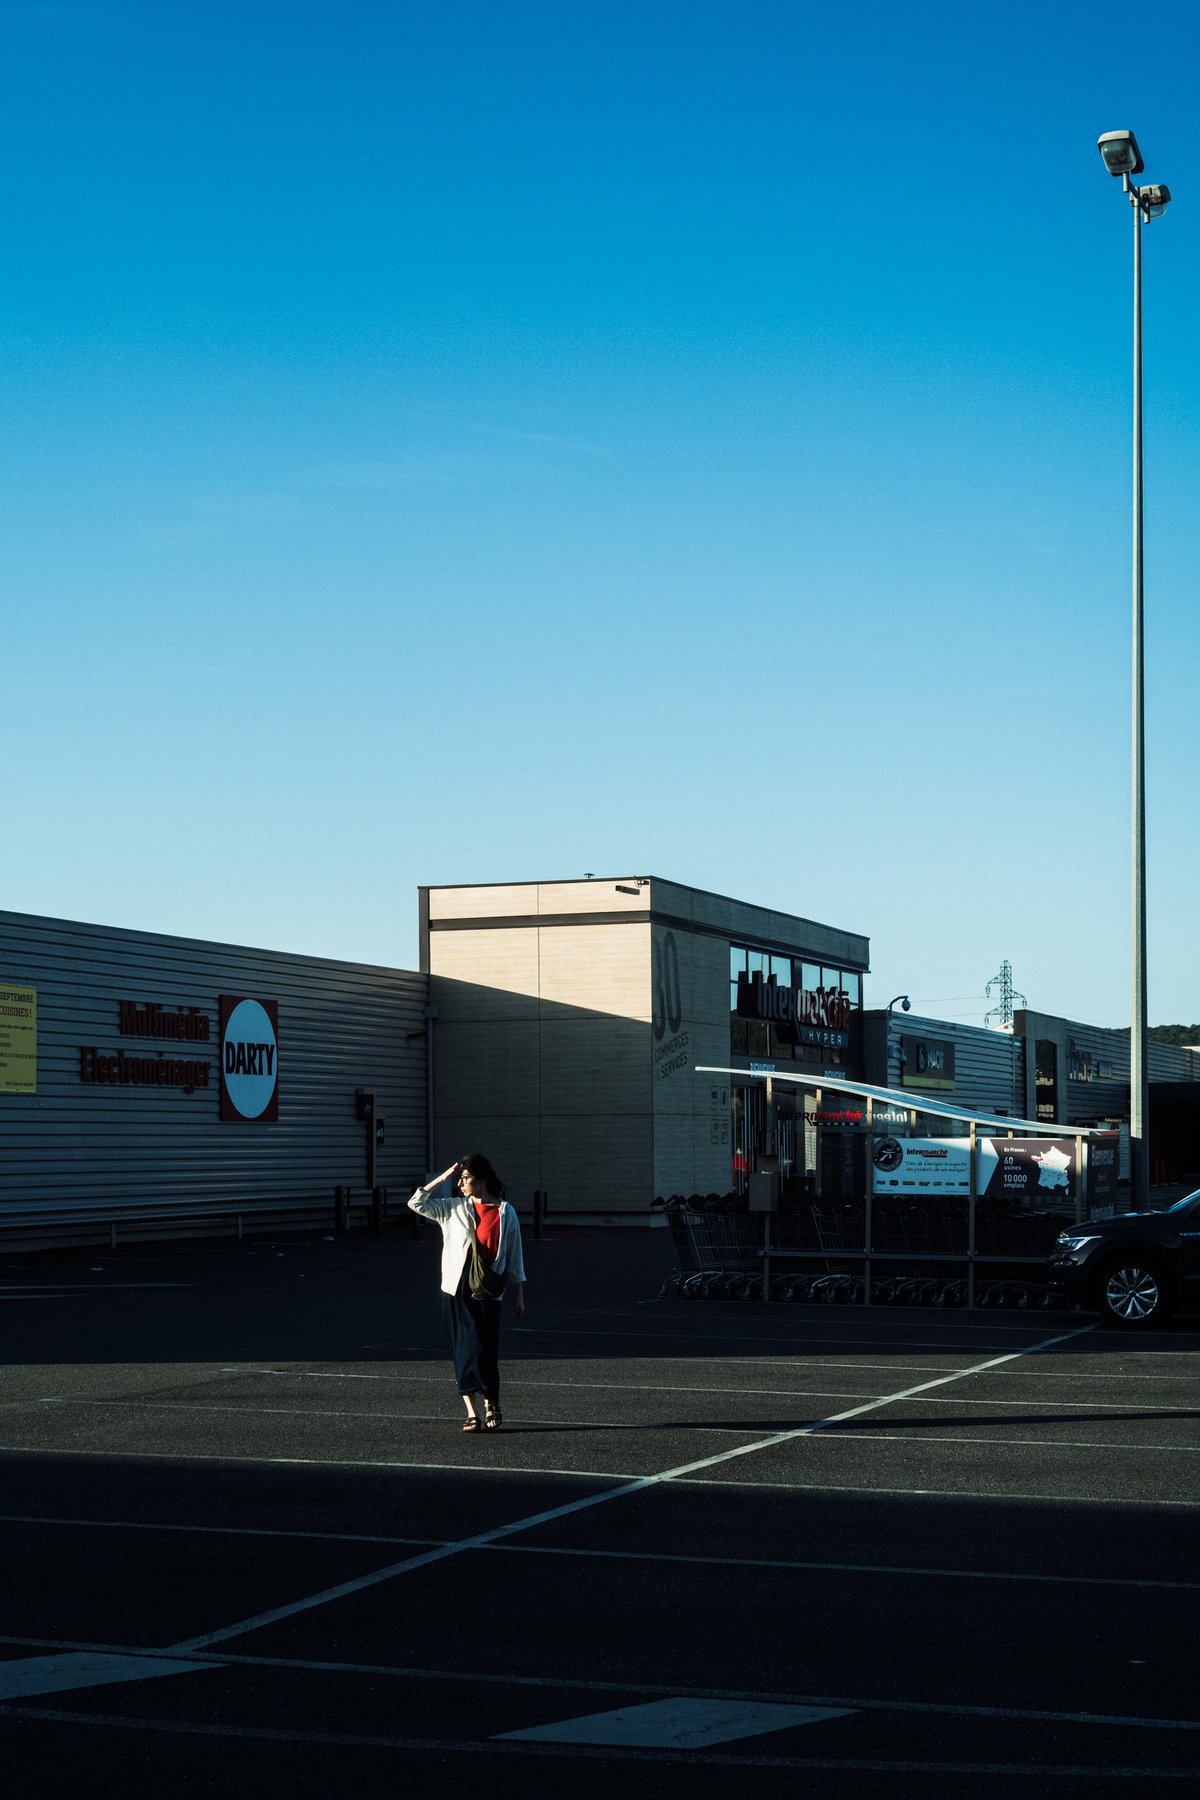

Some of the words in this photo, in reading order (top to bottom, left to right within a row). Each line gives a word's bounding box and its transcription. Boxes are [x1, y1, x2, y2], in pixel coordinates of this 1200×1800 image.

[0, 992, 34, 1003] SEPTEMBRE
[119, 1000, 209, 1040] Multimédia
[654, 1030, 689, 1063] COMMERCES
[808, 1030, 843, 1045] HYPER
[225, 1041, 275, 1075] DARTY
[661, 1051, 688, 1080] SERVICES
[80, 1047, 211, 1094] Electroménager
[778, 1110, 864, 1122] Intermarché
[906, 1148, 949, 1157] Intermarché
[1003, 1157, 1014, 1165] 60
